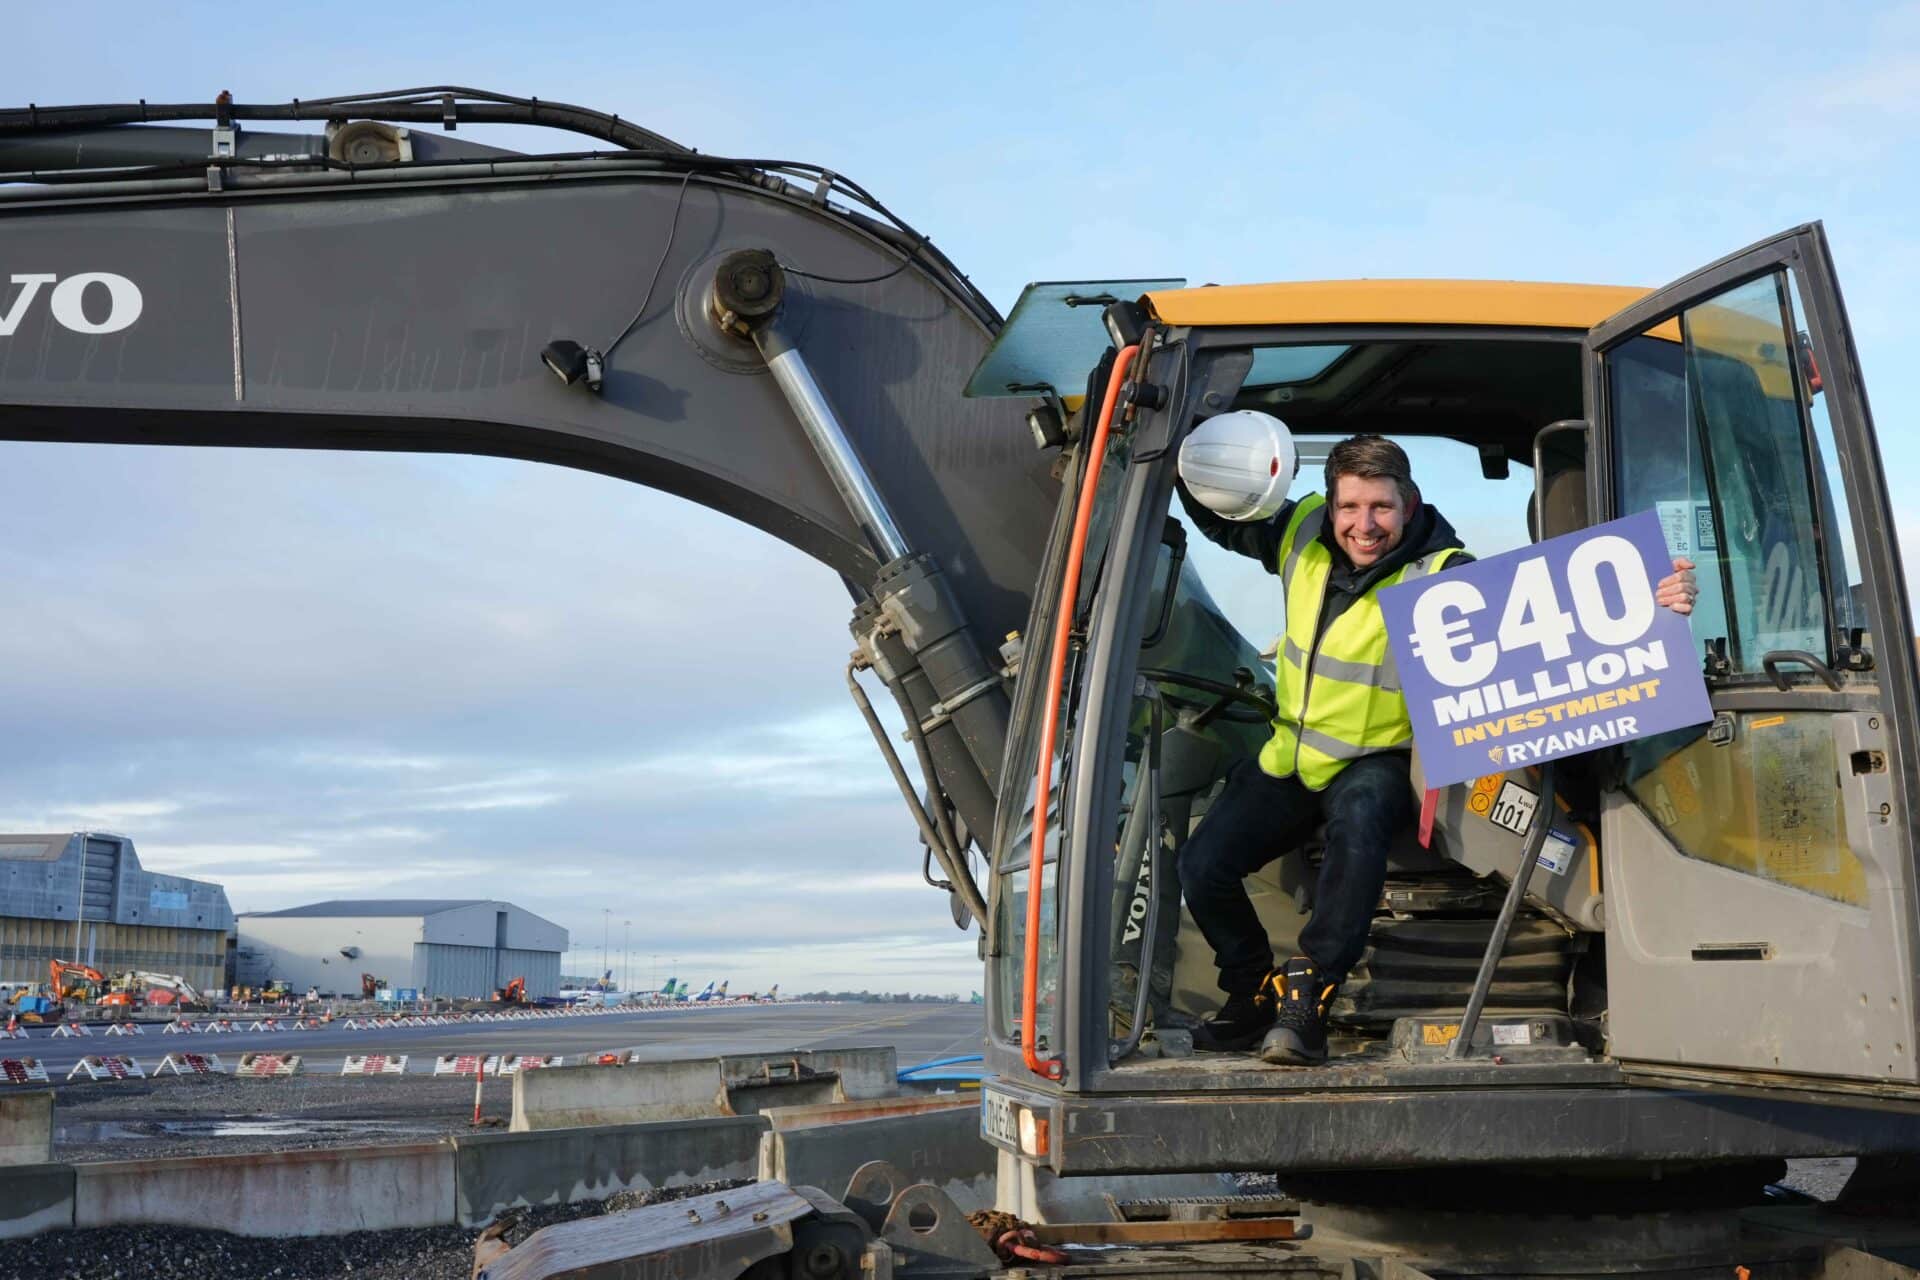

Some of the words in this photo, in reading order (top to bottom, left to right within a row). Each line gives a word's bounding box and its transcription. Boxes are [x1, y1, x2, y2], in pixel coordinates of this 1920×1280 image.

[1408, 535, 1656, 688] €40
[1432, 640, 1669, 727] MILLION
[1453, 679, 1661, 746] INVESTMENT
[1507, 715, 1640, 764] RYANAIR
[1494, 800, 1526, 830] 101
